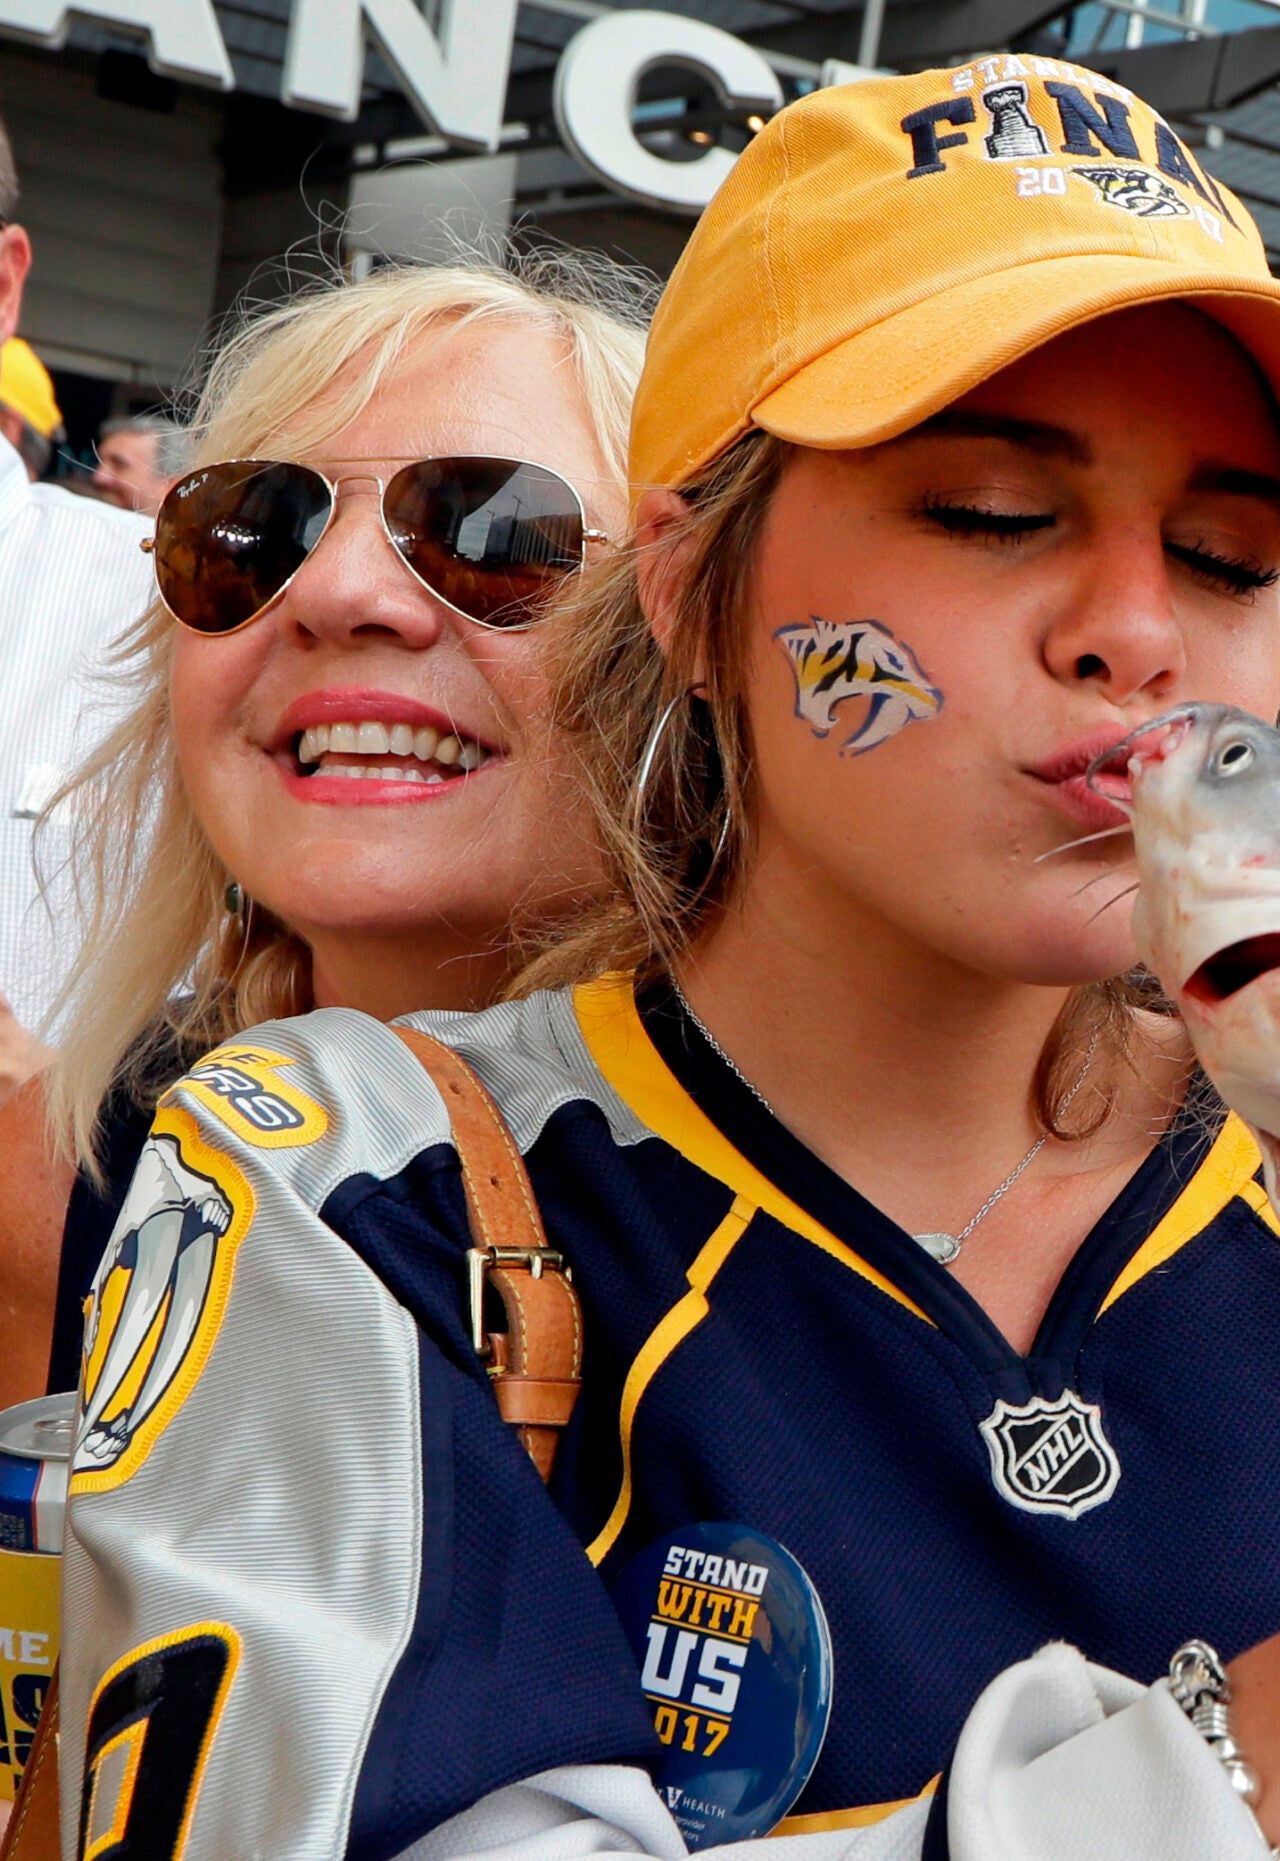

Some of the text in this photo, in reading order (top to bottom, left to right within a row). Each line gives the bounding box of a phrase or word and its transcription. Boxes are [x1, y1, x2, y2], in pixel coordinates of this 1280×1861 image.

[1014, 166, 1068, 198] 20
[1023, 1422, 1085, 1492] NHL
[663, 1545, 769, 1596] STAND
[657, 1580, 760, 1638] WITH
[641, 1622, 749, 1714] US
[654, 1706, 730, 1757] 017
[682, 1796, 726, 1820] HEALTH
